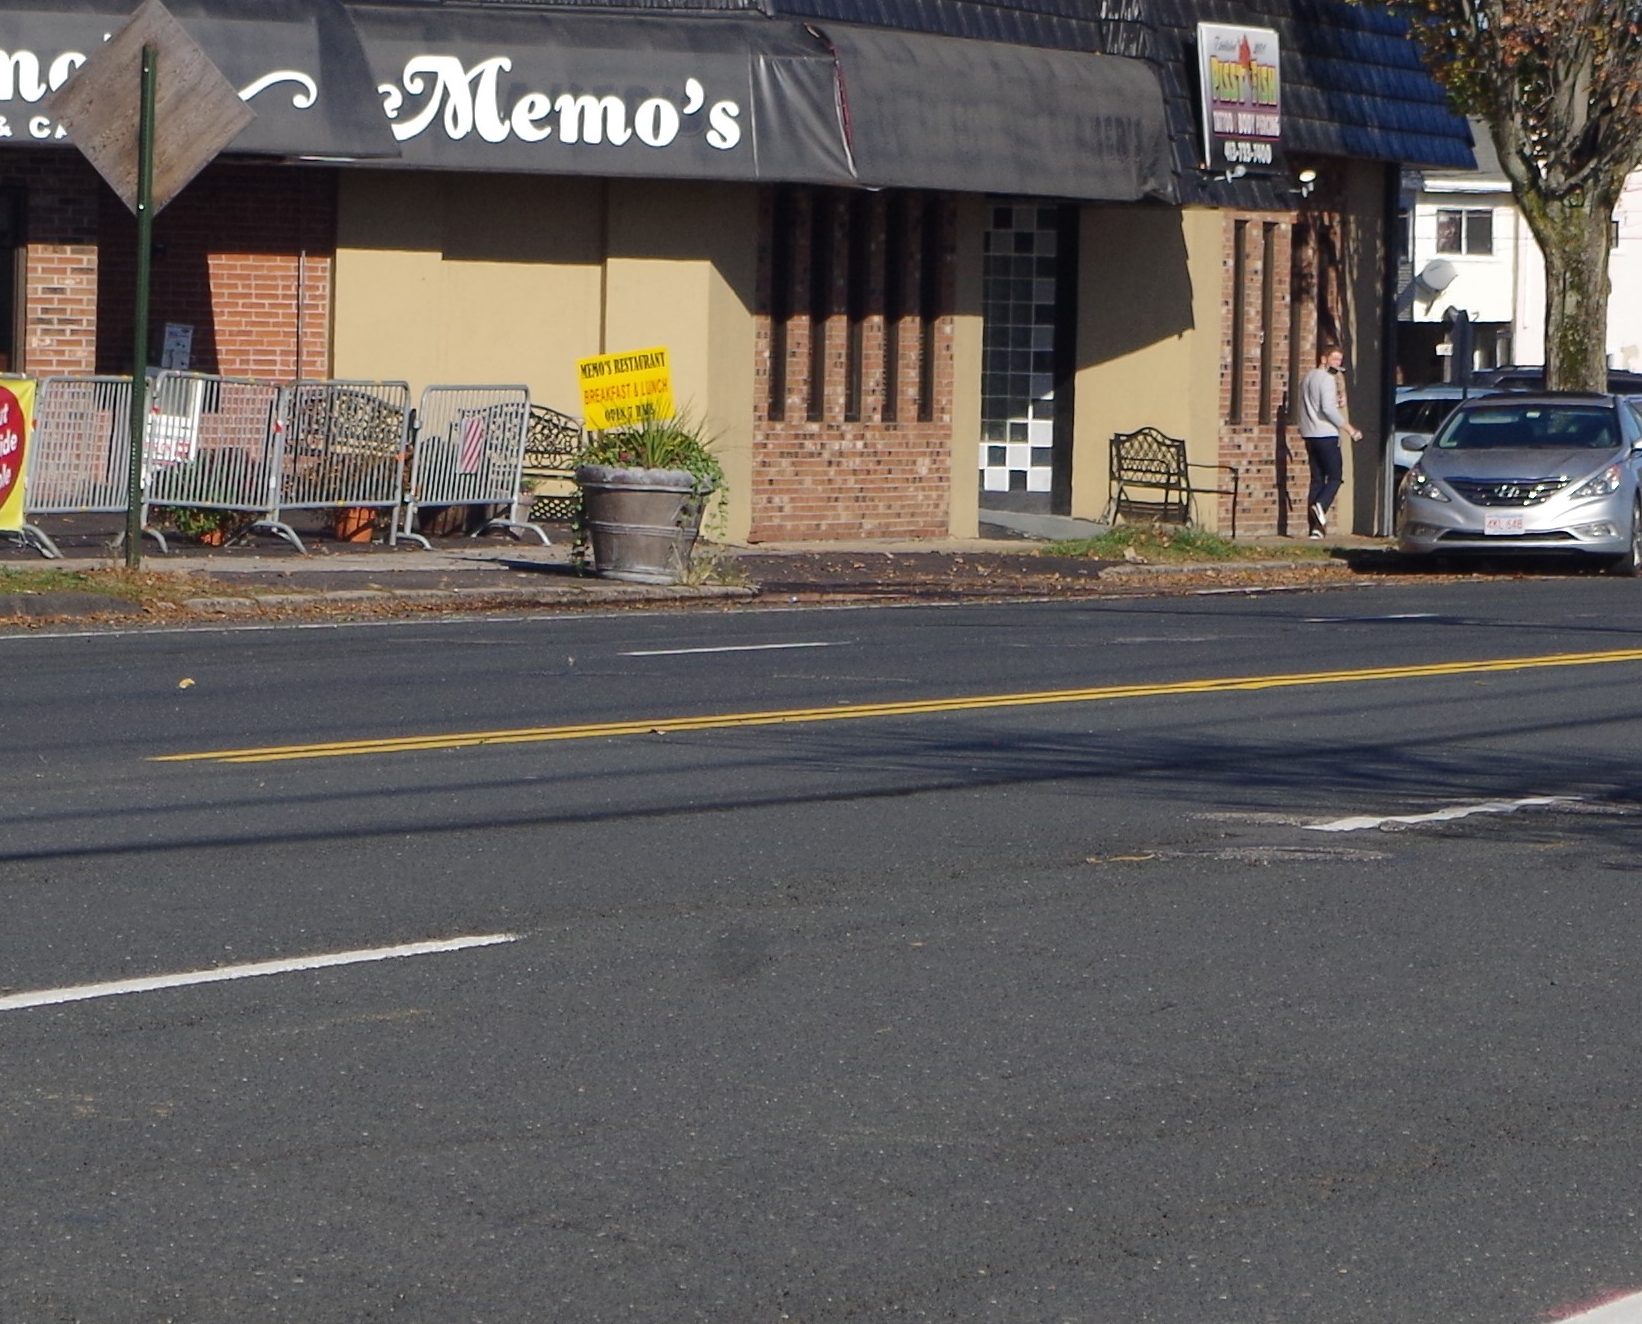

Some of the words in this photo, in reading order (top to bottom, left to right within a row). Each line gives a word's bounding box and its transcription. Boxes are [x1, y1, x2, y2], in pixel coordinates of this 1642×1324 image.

[378, 55, 741, 150] Memo's
[580, 360, 613, 379] MEMO'S
[614, 352, 666, 374] RESTAURANT
[584, 383, 632, 405] BREAKFAST
[641, 378, 668, 396] LUNCH
[605, 407, 627, 422] OPEN
